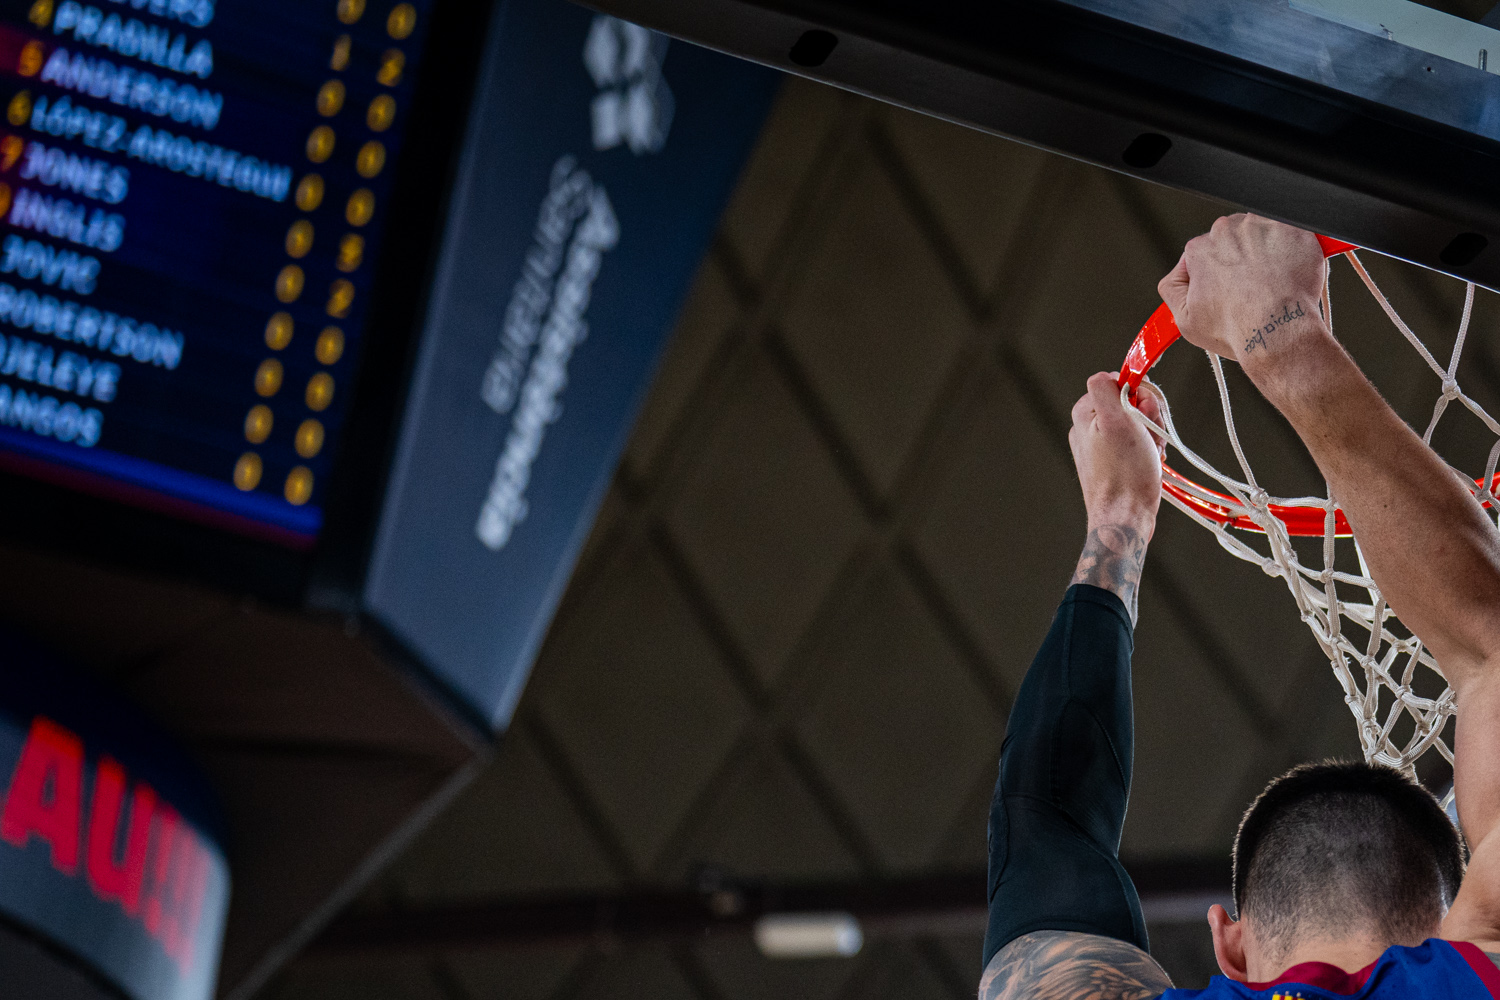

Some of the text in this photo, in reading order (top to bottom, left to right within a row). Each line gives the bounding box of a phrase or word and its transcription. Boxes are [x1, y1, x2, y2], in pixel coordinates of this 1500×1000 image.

[53, 1, 214, 79] PRADILLA
[317, 80, 345, 117] 0
[366, 94, 396, 132] 0
[41, 47, 223, 130] ANDERSON
[306, 125, 336, 163] 0
[356, 141, 386, 178] 0
[20, 141, 130, 204] JONES
[286, 220, 314, 259] 0
[295, 174, 324, 212] 0
[345, 189, 375, 227] 0
[9, 187, 125, 252] INGLIS
[276, 264, 305, 303] 0
[265, 313, 294, 351] 0
[315, 327, 344, 366] 0
[255, 359, 283, 397] 0
[305, 373, 334, 411] 0
[245, 404, 274, 444] 0
[294, 419, 324, 458] 0
[233, 452, 263, 491] 0
[284, 466, 313, 505] 0
